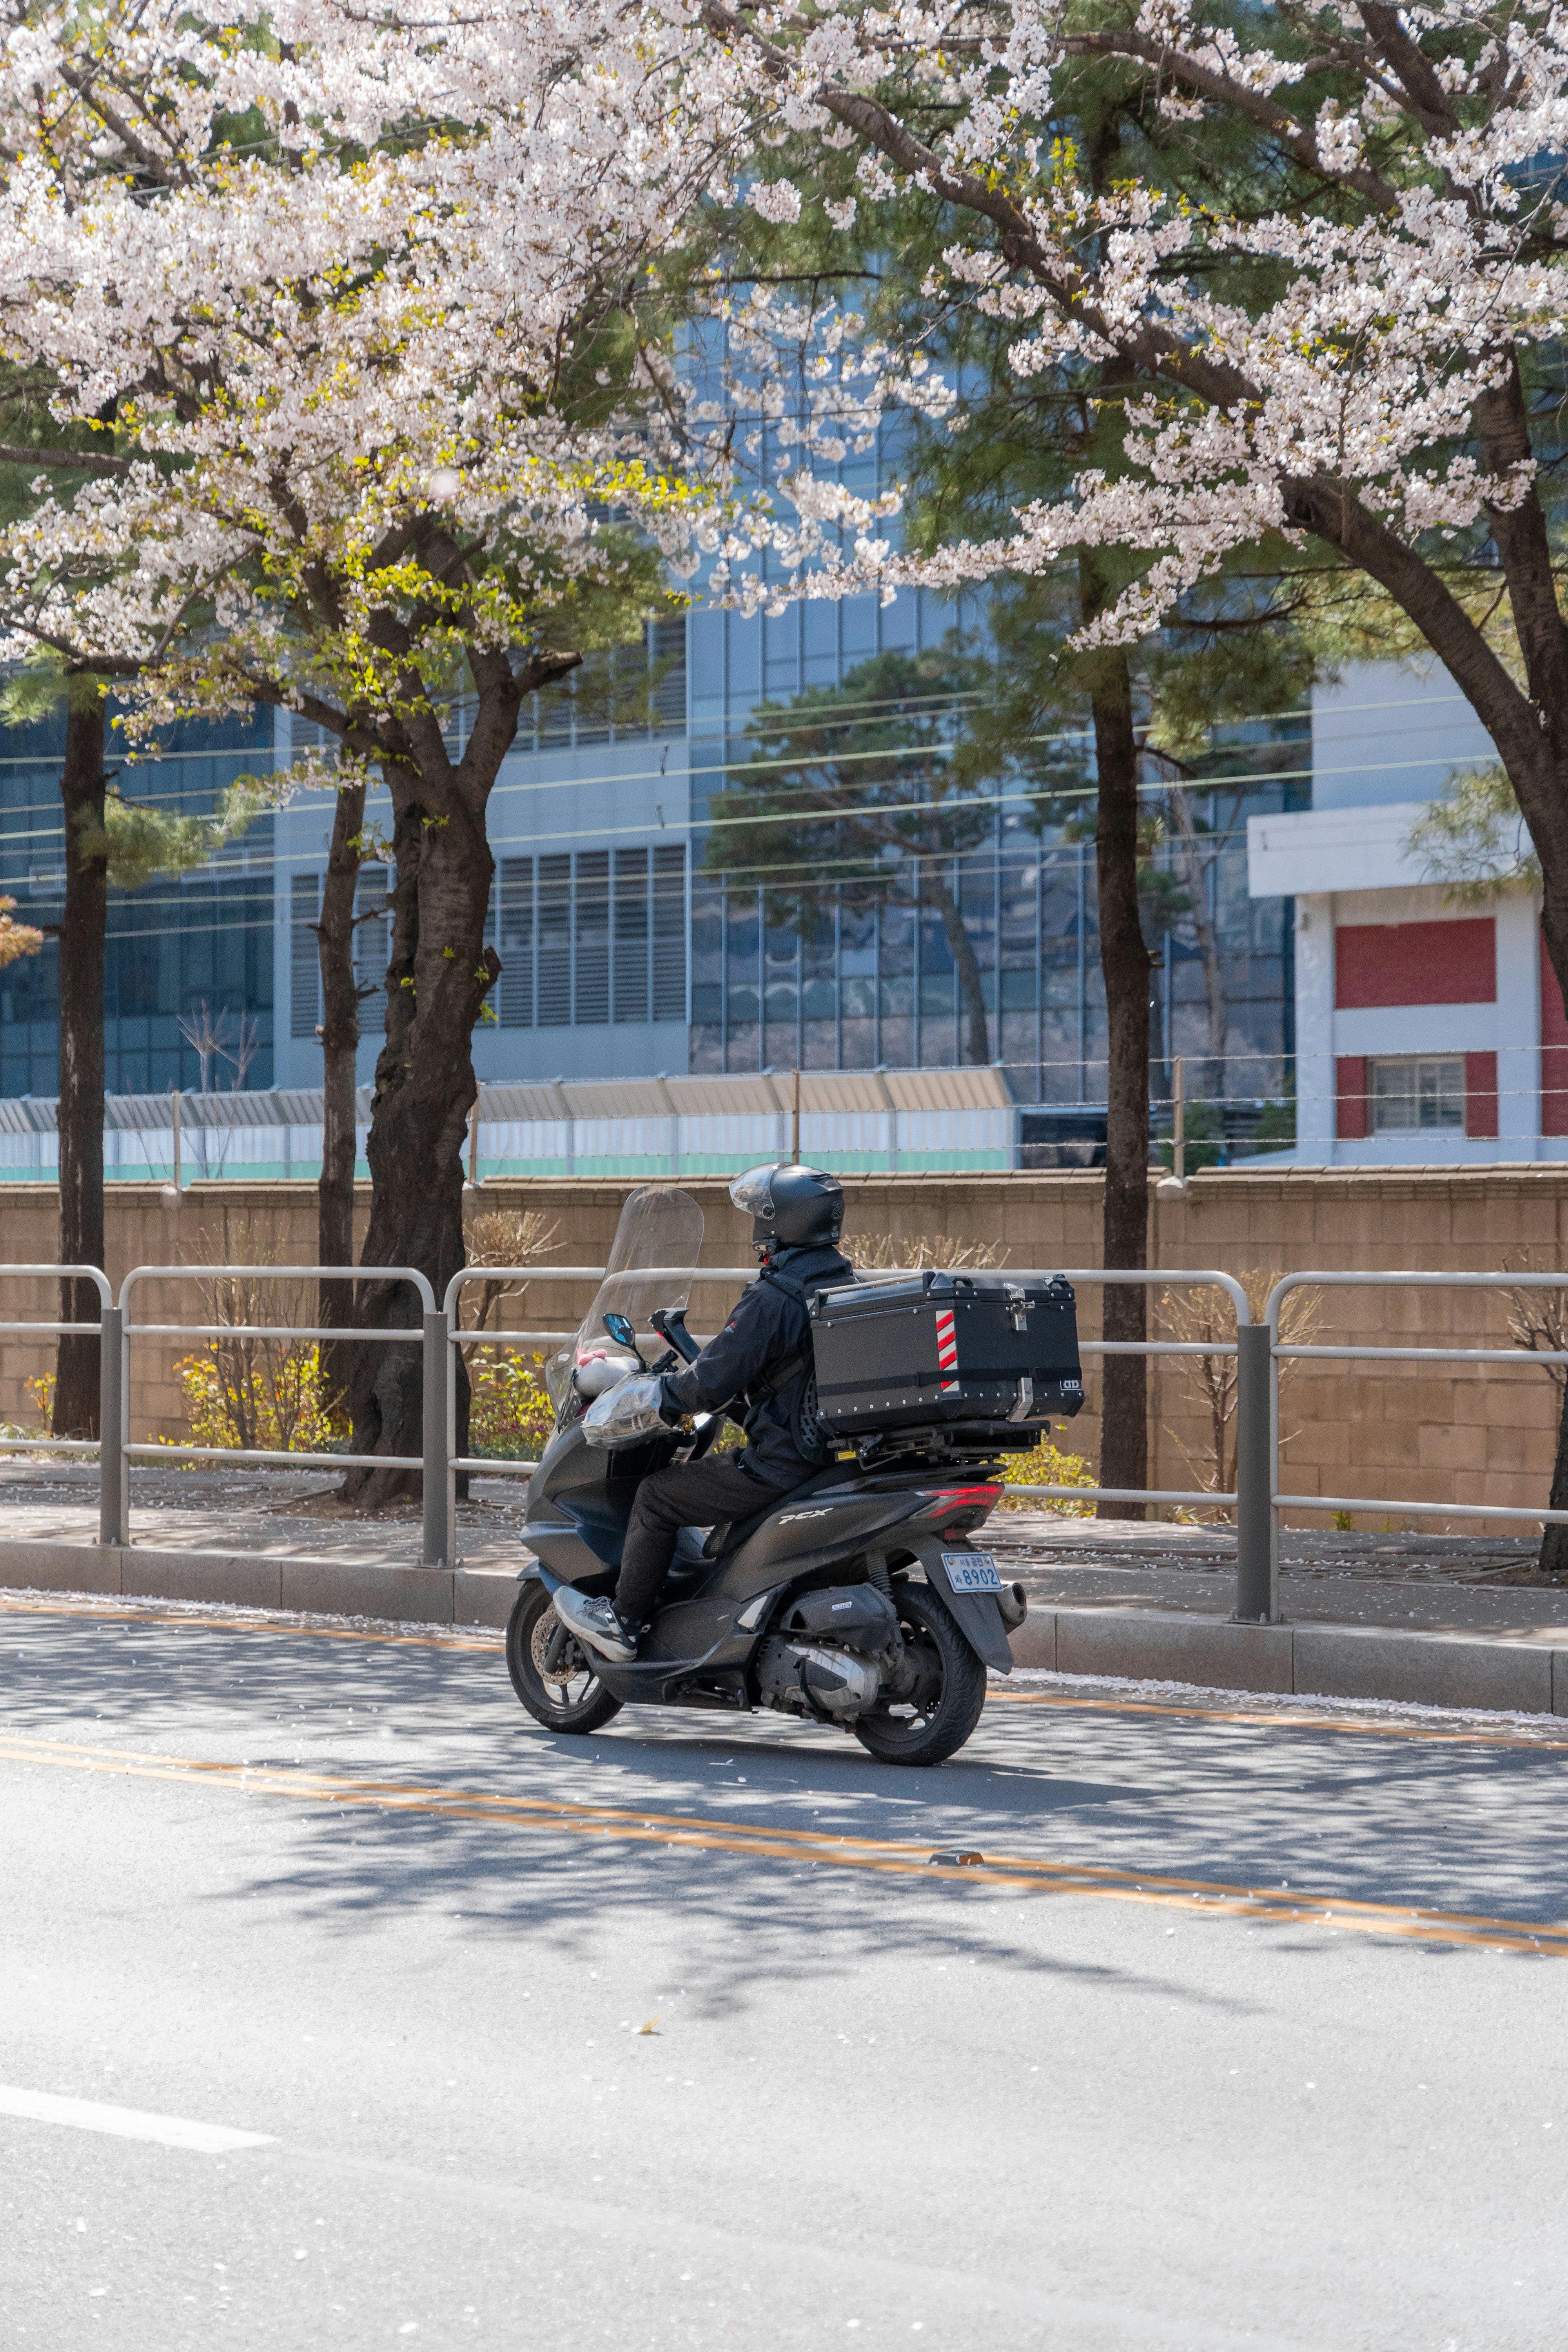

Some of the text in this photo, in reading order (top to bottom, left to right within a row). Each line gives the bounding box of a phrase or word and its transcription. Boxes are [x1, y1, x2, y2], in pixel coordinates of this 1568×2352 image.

[778, 1508, 834, 1524] PCX
[960, 1558, 970, 1566] 서울
[962, 1569, 998, 1585] 8902
